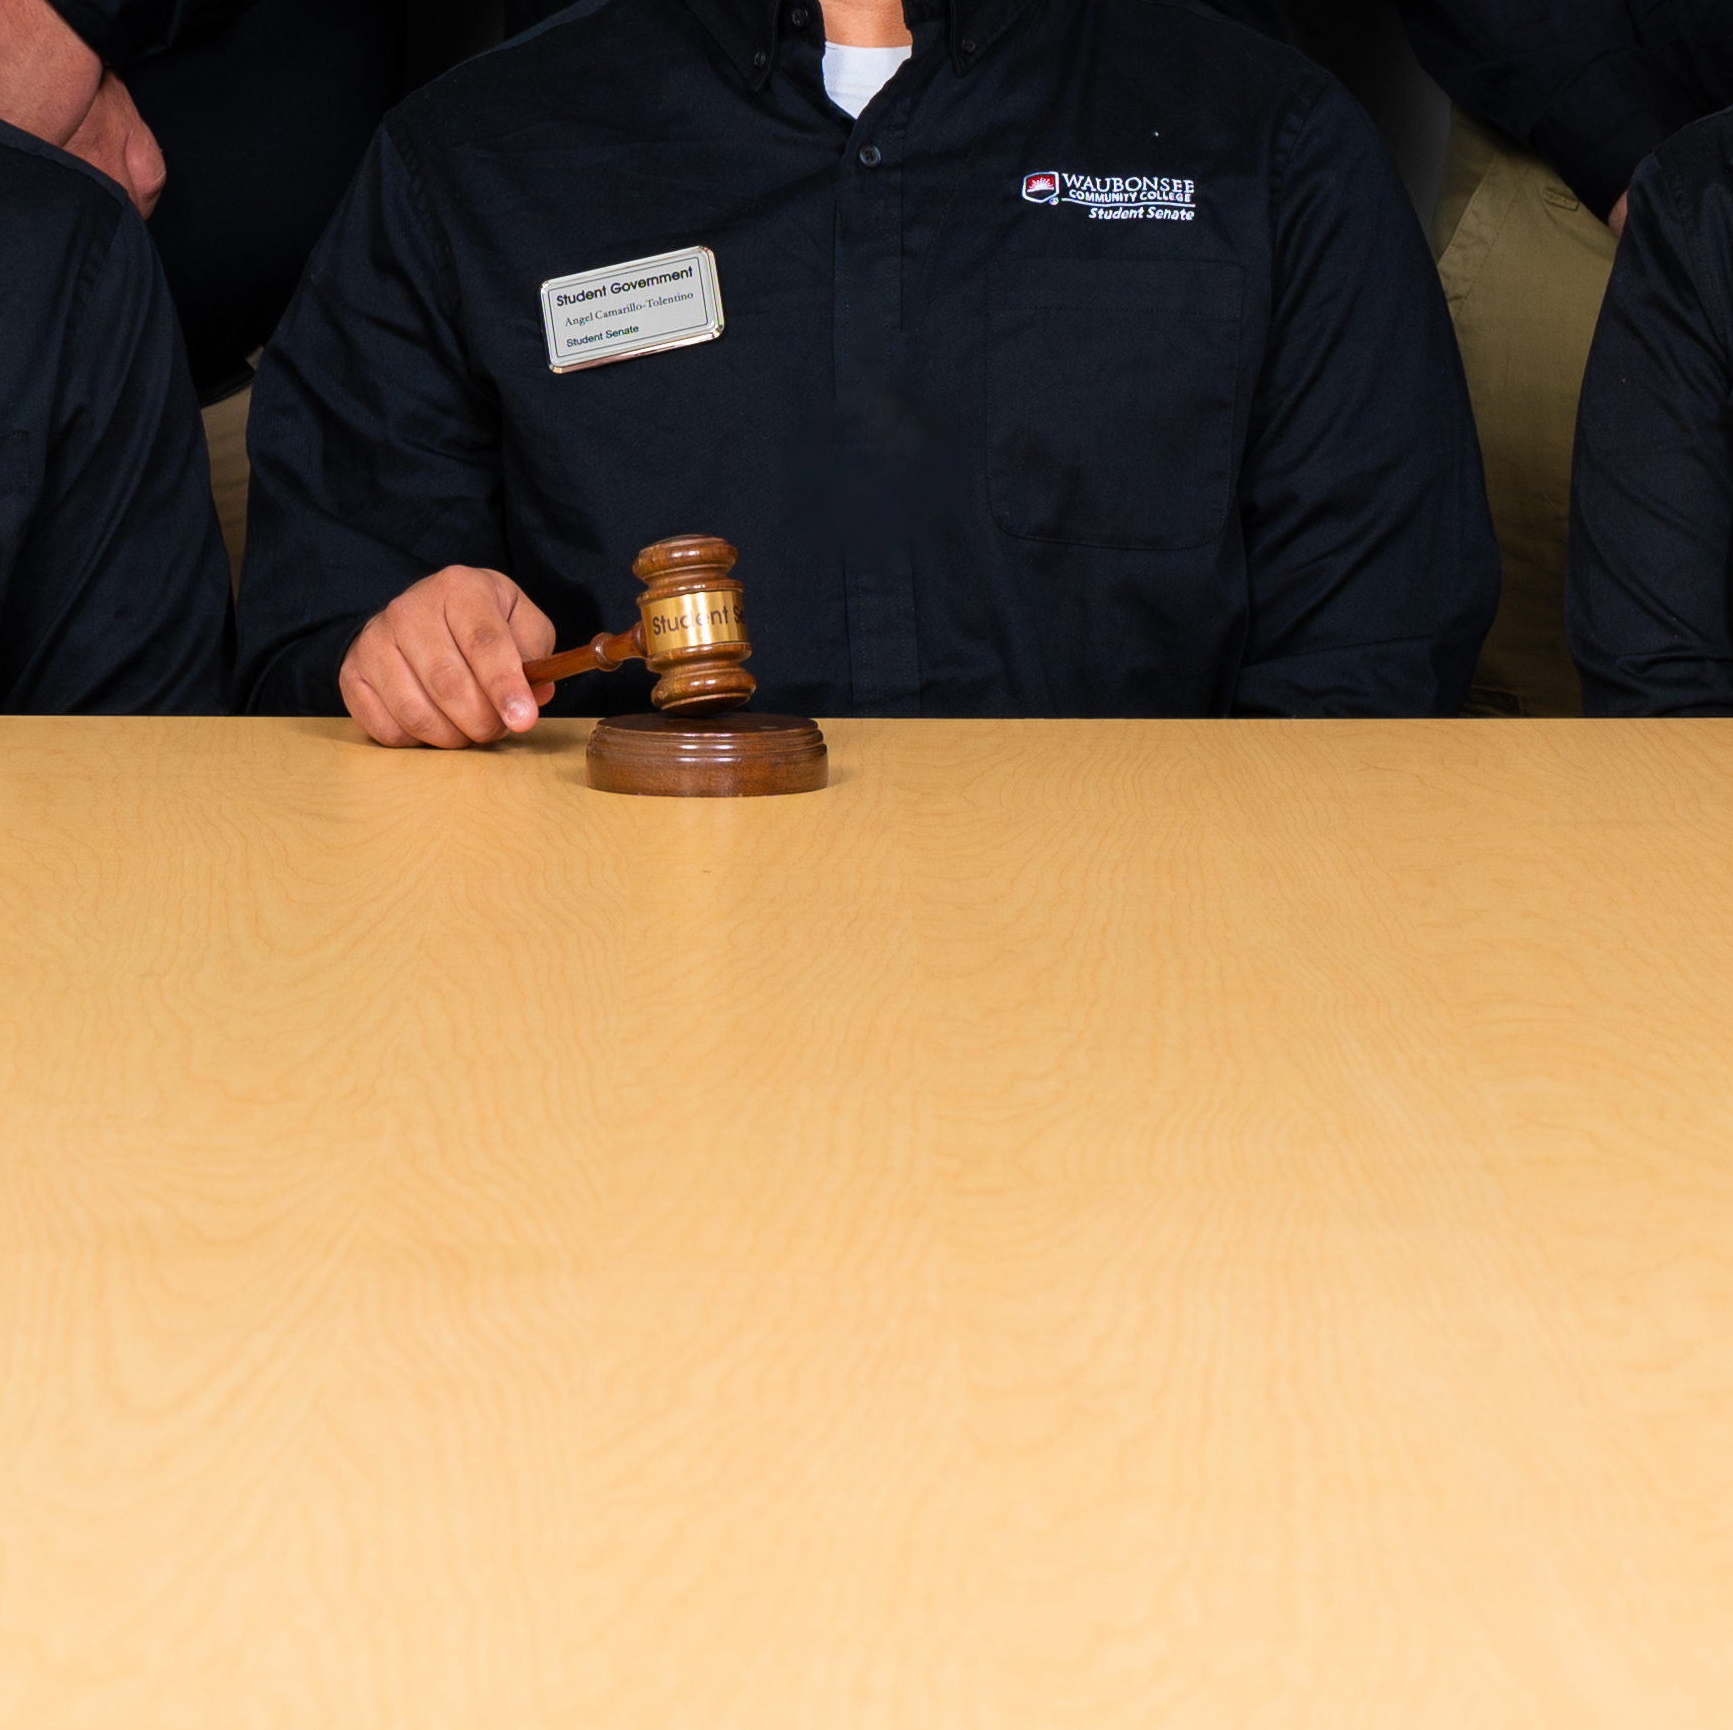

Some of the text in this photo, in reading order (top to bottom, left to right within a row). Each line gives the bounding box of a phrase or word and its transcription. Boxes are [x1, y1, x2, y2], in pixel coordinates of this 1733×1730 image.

[1062, 173, 1194, 193] WAUBONSEE
[1069, 189, 1191, 203] COMMUNITY COLLEGE
[1089, 206, 1194, 220] Student Senate
[557, 266, 693, 307] Student Government
[565, 292, 694, 327] Angel Camarillo-Tolentino
[566, 325, 639, 348] Student Senate
[652, 605, 729, 636] Student
